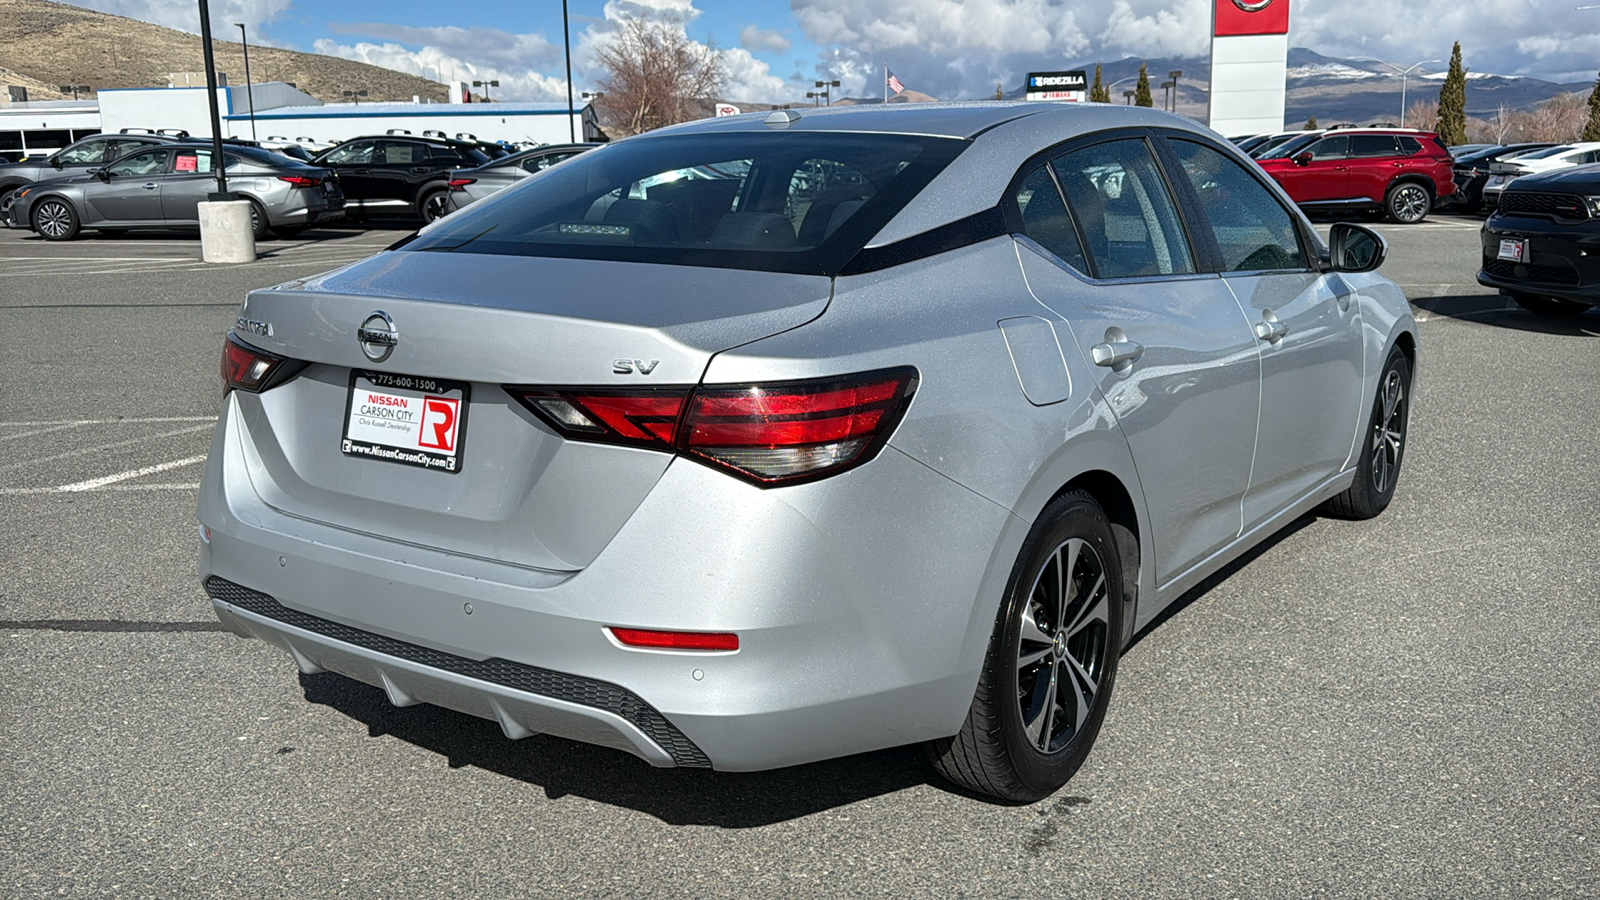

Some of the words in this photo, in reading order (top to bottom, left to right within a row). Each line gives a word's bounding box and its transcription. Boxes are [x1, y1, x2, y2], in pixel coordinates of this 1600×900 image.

[1043, 76, 1084, 86] RIDEZILLA
[358, 329, 392, 341] NISSAN
[613, 359, 660, 375] SV
[378, 374, 436, 390] 775-600-1500
[368, 394, 408, 408] NISSAN
[360, 404, 395, 418] CARSON
[396, 410, 414, 421] CITY
[359, 418, 371, 426] Chris
[372, 419, 387, 428] Russell
[387, 422, 411, 433] Dealership
[351, 444, 446, 467] www.NissanCarsonCity.com
